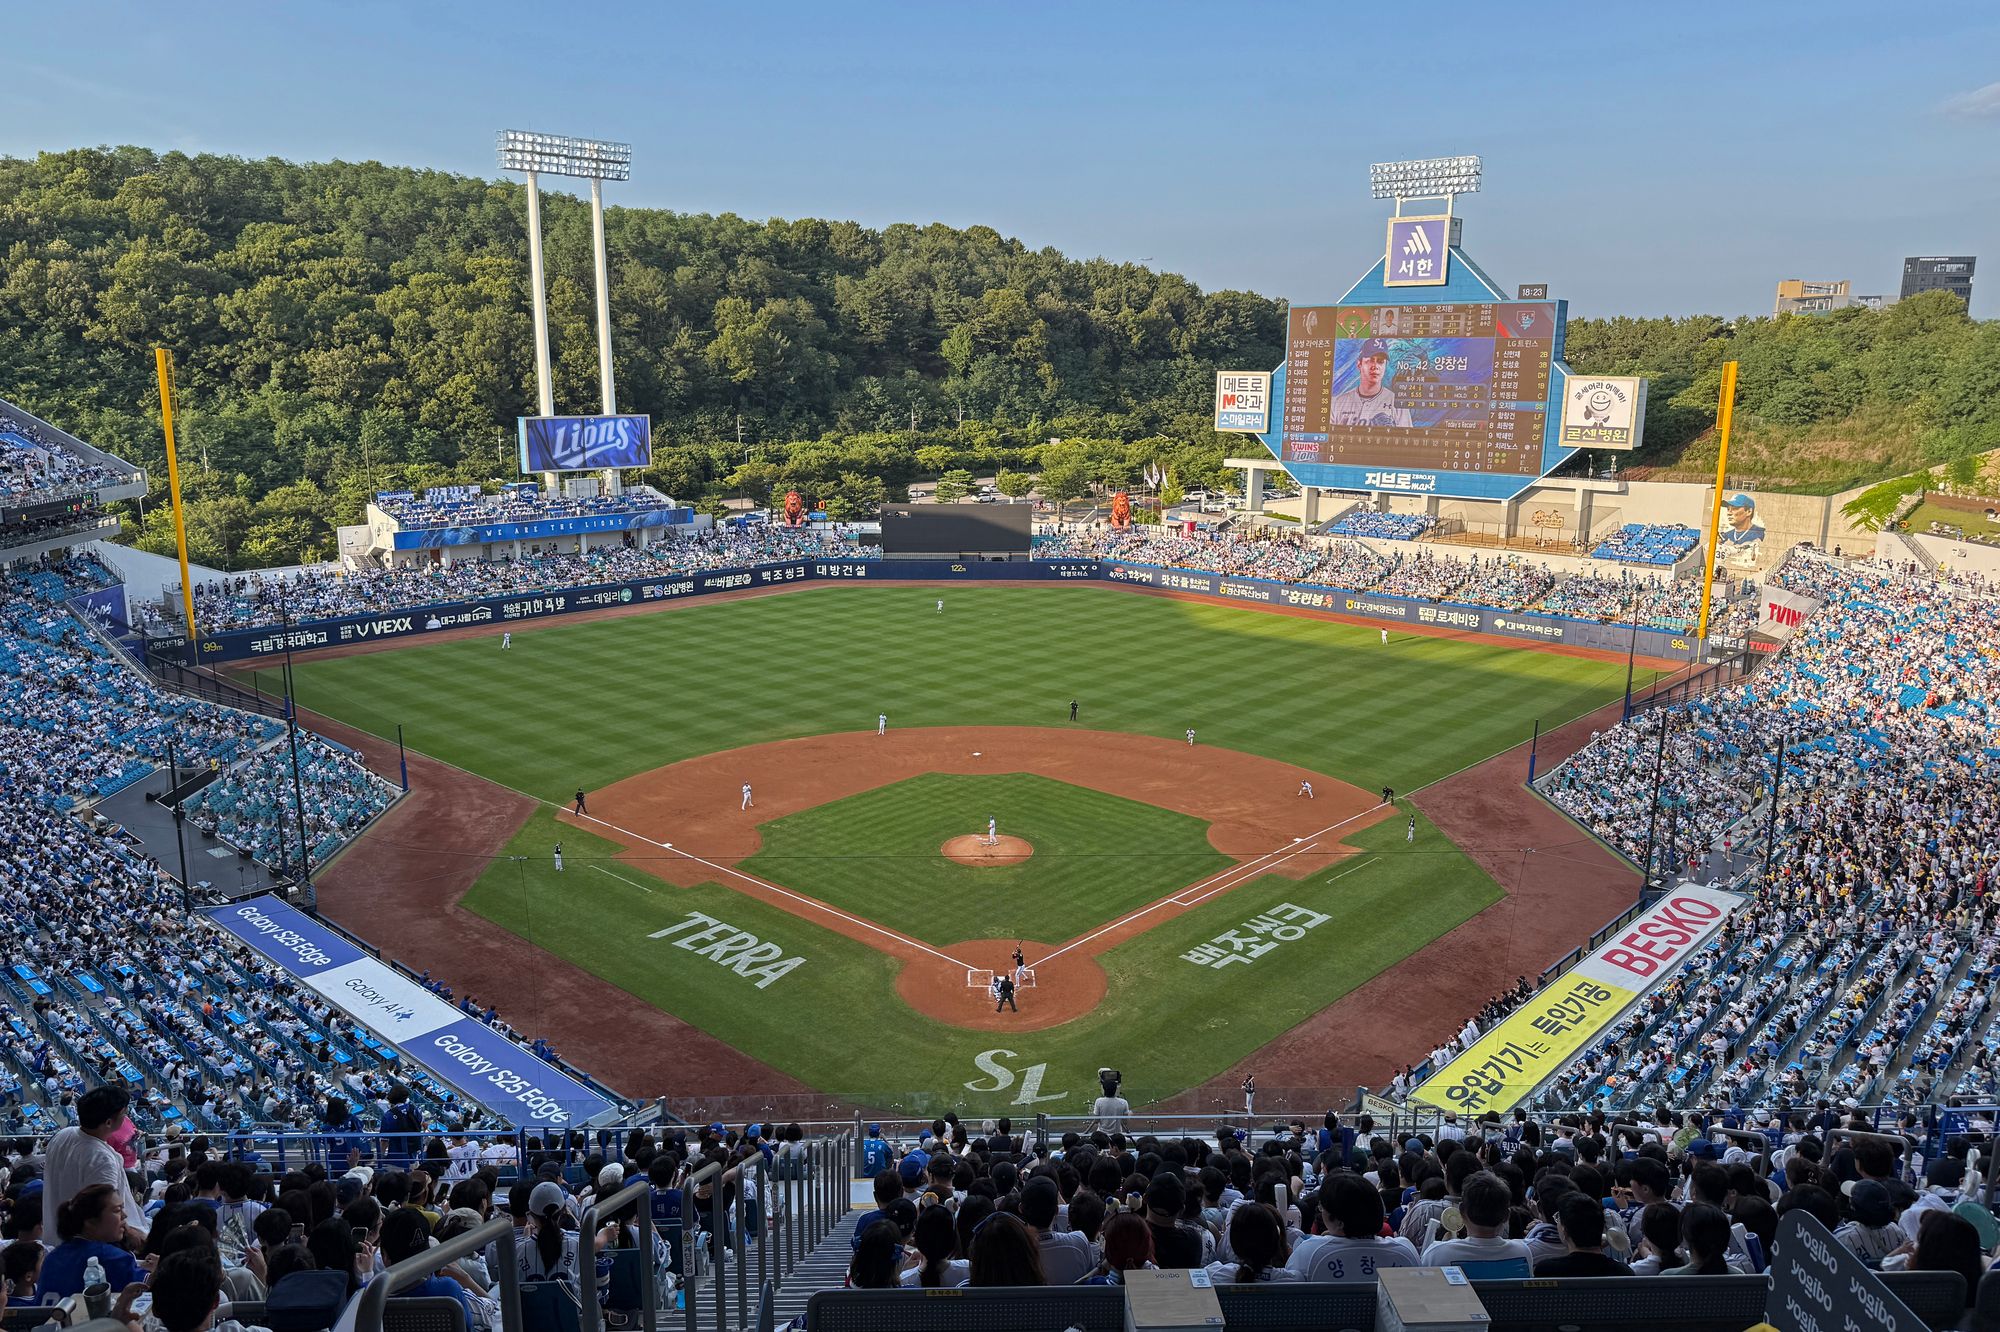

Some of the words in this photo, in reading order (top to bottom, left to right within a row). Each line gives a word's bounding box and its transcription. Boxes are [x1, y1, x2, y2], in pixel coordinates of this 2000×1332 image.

[1399, 259, 1433, 277] 서한
[1522, 288, 1543, 296] 18:23
[1293, 340, 1305, 348] 삼성
[1306, 340, 1330, 348] 라이온즈
[1397, 362, 1411, 370] No.
[1416, 361, 1428, 370] 42
[1434, 357, 1468, 371] 양창섭
[1224, 378, 1263, 392] 메트로
[1574, 382, 1603, 401] 굳세어라
[1221, 414, 1262, 426] 스마일라식
[553, 418, 629, 461] Lions
[1291, 442, 1319, 452] TWINS
[1365, 472, 1411, 490] 지브로
[1411, 480, 1436, 491] mart
[514, 525, 539, 534] ARE
[550, 522, 574, 532] THE
[585, 518, 624, 528] LIONS
[1716, 551, 1726, 559] 36
[762, 566, 805, 582] 백조씽크
[817, 564, 866, 576] 대방건설
[663, 581, 694, 596] 삼일병원
[594, 590, 621, 604] 데일리
[441, 615, 456, 626] 대구
[1437, 610, 1480, 628] 로제비앙
[1507, 622, 1563, 637] 대백저축은행
[203, 641, 224, 653] 99m
[1671, 638, 1690, 650] 99m
[236, 906, 285, 935] Galaxy
[273, 928, 300, 953] S25
[296, 942, 332, 968] Edge
[1178, 902, 1333, 970] 백조씽크
[1601, 896, 1722, 978] BESKO
[646, 911, 807, 990] TERRA
[345, 978, 386, 1008] Galaxy
[1531, 981, 1612, 1037] 특인기공
[434, 1034, 493, 1076] Galaxy
[488, 1068, 525, 1095] S25
[519, 1087, 570, 1124] Edge
[963, 1048, 1068, 1106] SL
[1368, 1098, 1394, 1112] BESKO
[868, 1151, 876, 1164] 5
[460, 1160, 472, 1174] 41
[1795, 1221, 1838, 1274] yogibo
[1790, 1258, 1832, 1312] yogibo
[1849, 1275, 1897, 1332] yogibo
